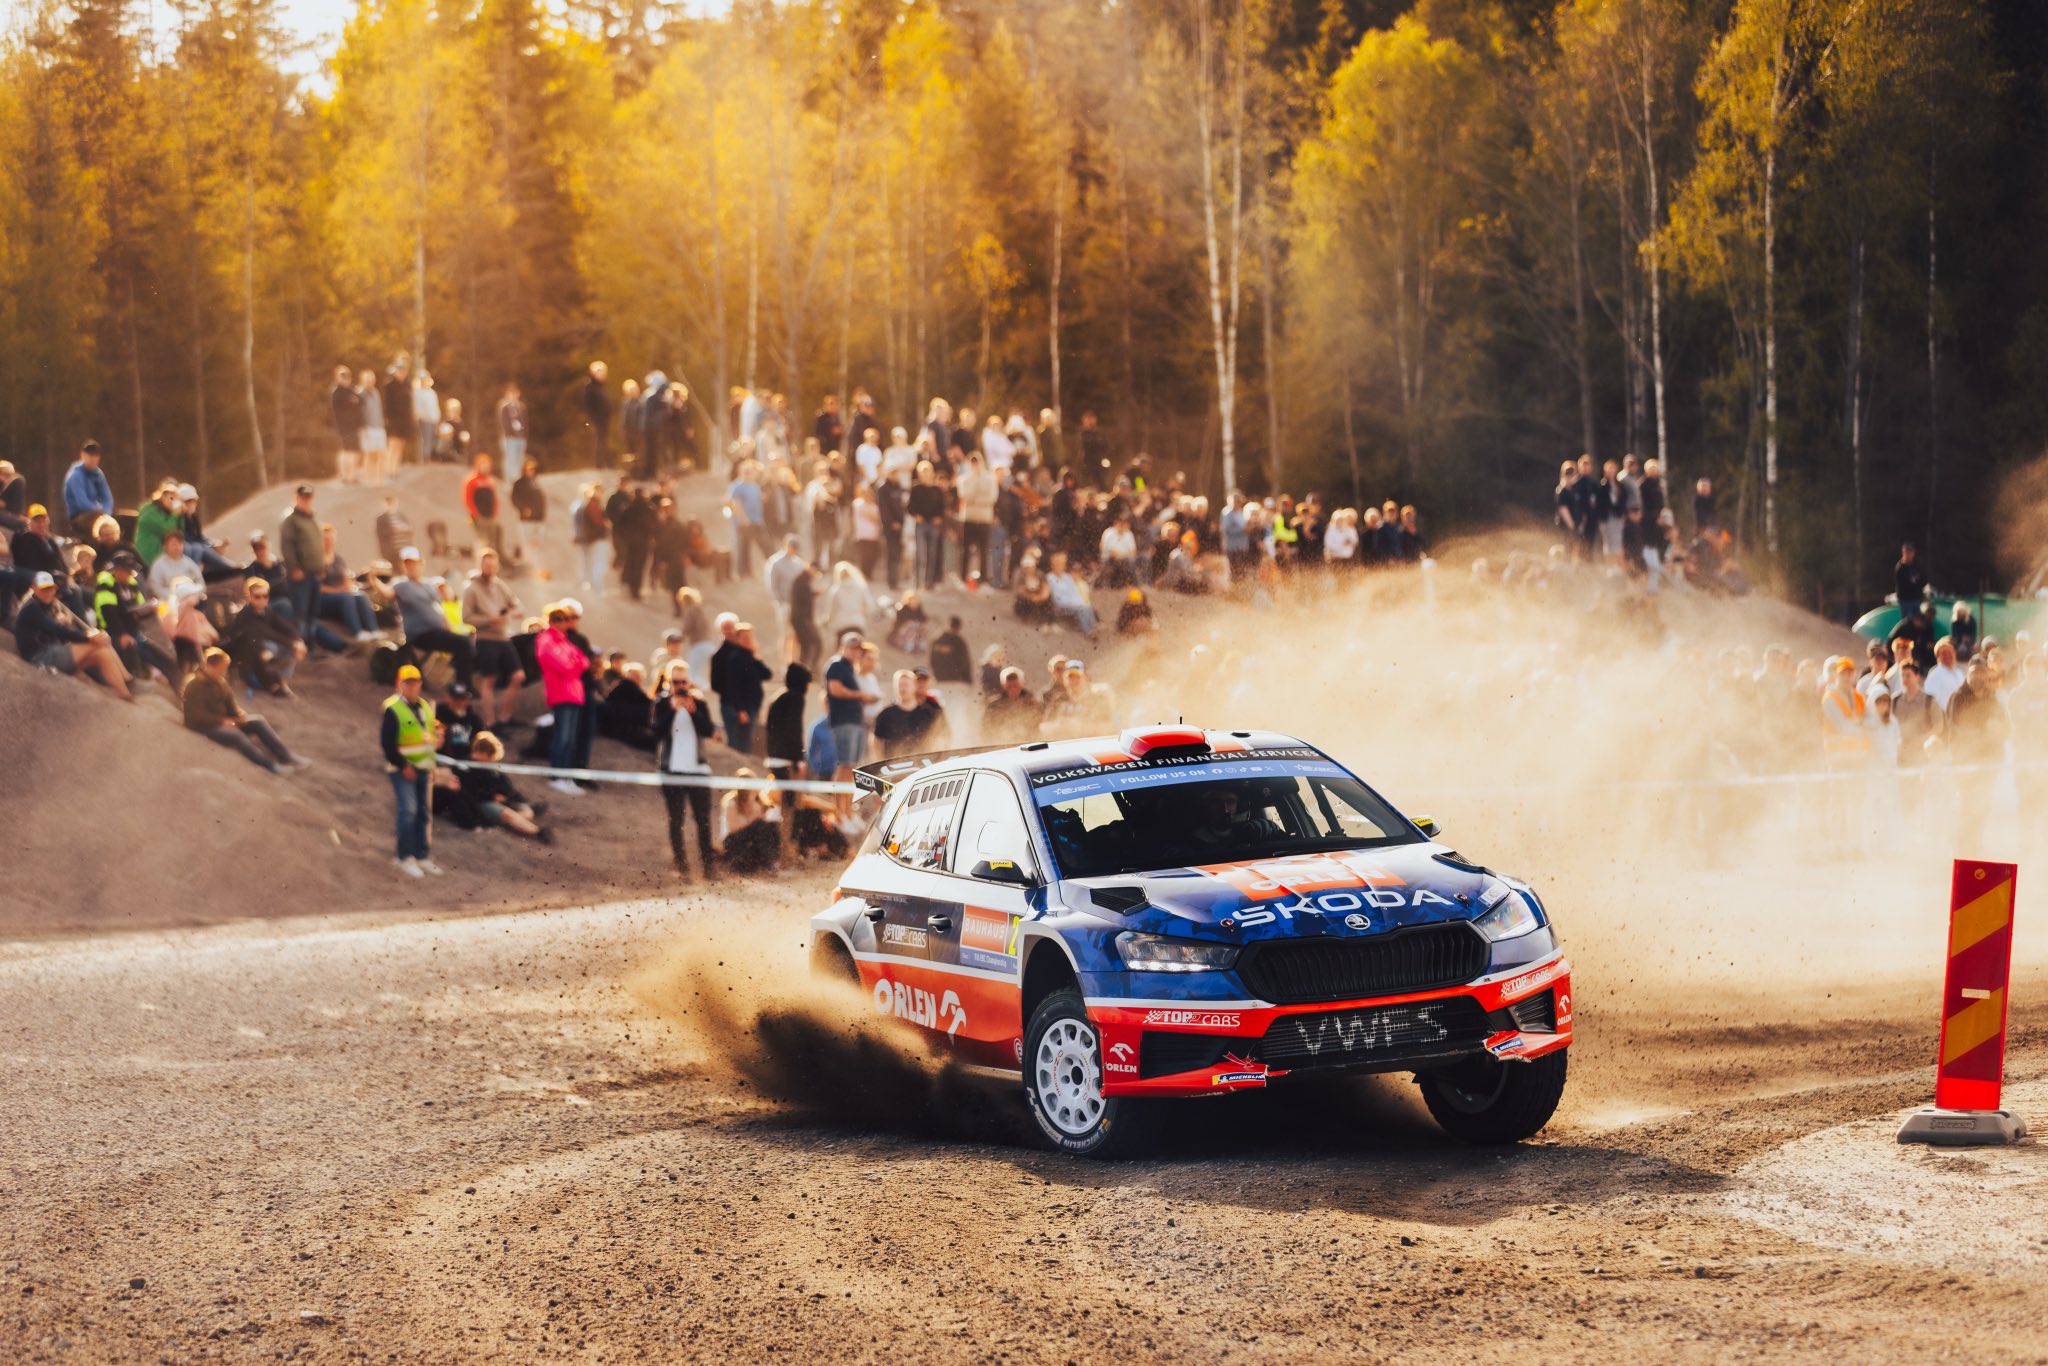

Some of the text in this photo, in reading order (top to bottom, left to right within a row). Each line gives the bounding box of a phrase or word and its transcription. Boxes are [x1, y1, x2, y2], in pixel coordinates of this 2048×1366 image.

[1033, 749, 1320, 785] VOLKSWAGEN FINANCIAL SERVICES
[1120, 769, 1206, 785] FOLLOW US ON
[1249, 868, 1387, 891] ORLEN
[891, 924, 927, 947] TOP CARS
[964, 917, 1006, 939] BAUHAUS
[1511, 969, 1552, 992] TOP CARS
[873, 978, 937, 1029] ORLEN
[1163, 1010, 1240, 1027] TOP CARS
[1295, 1004, 1448, 1055] VWFS
[1557, 1014, 1572, 1026] ORLEN
[1105, 1063, 1137, 1073] ORLEN
[1229, 1073, 1265, 1081] MICHELIN
